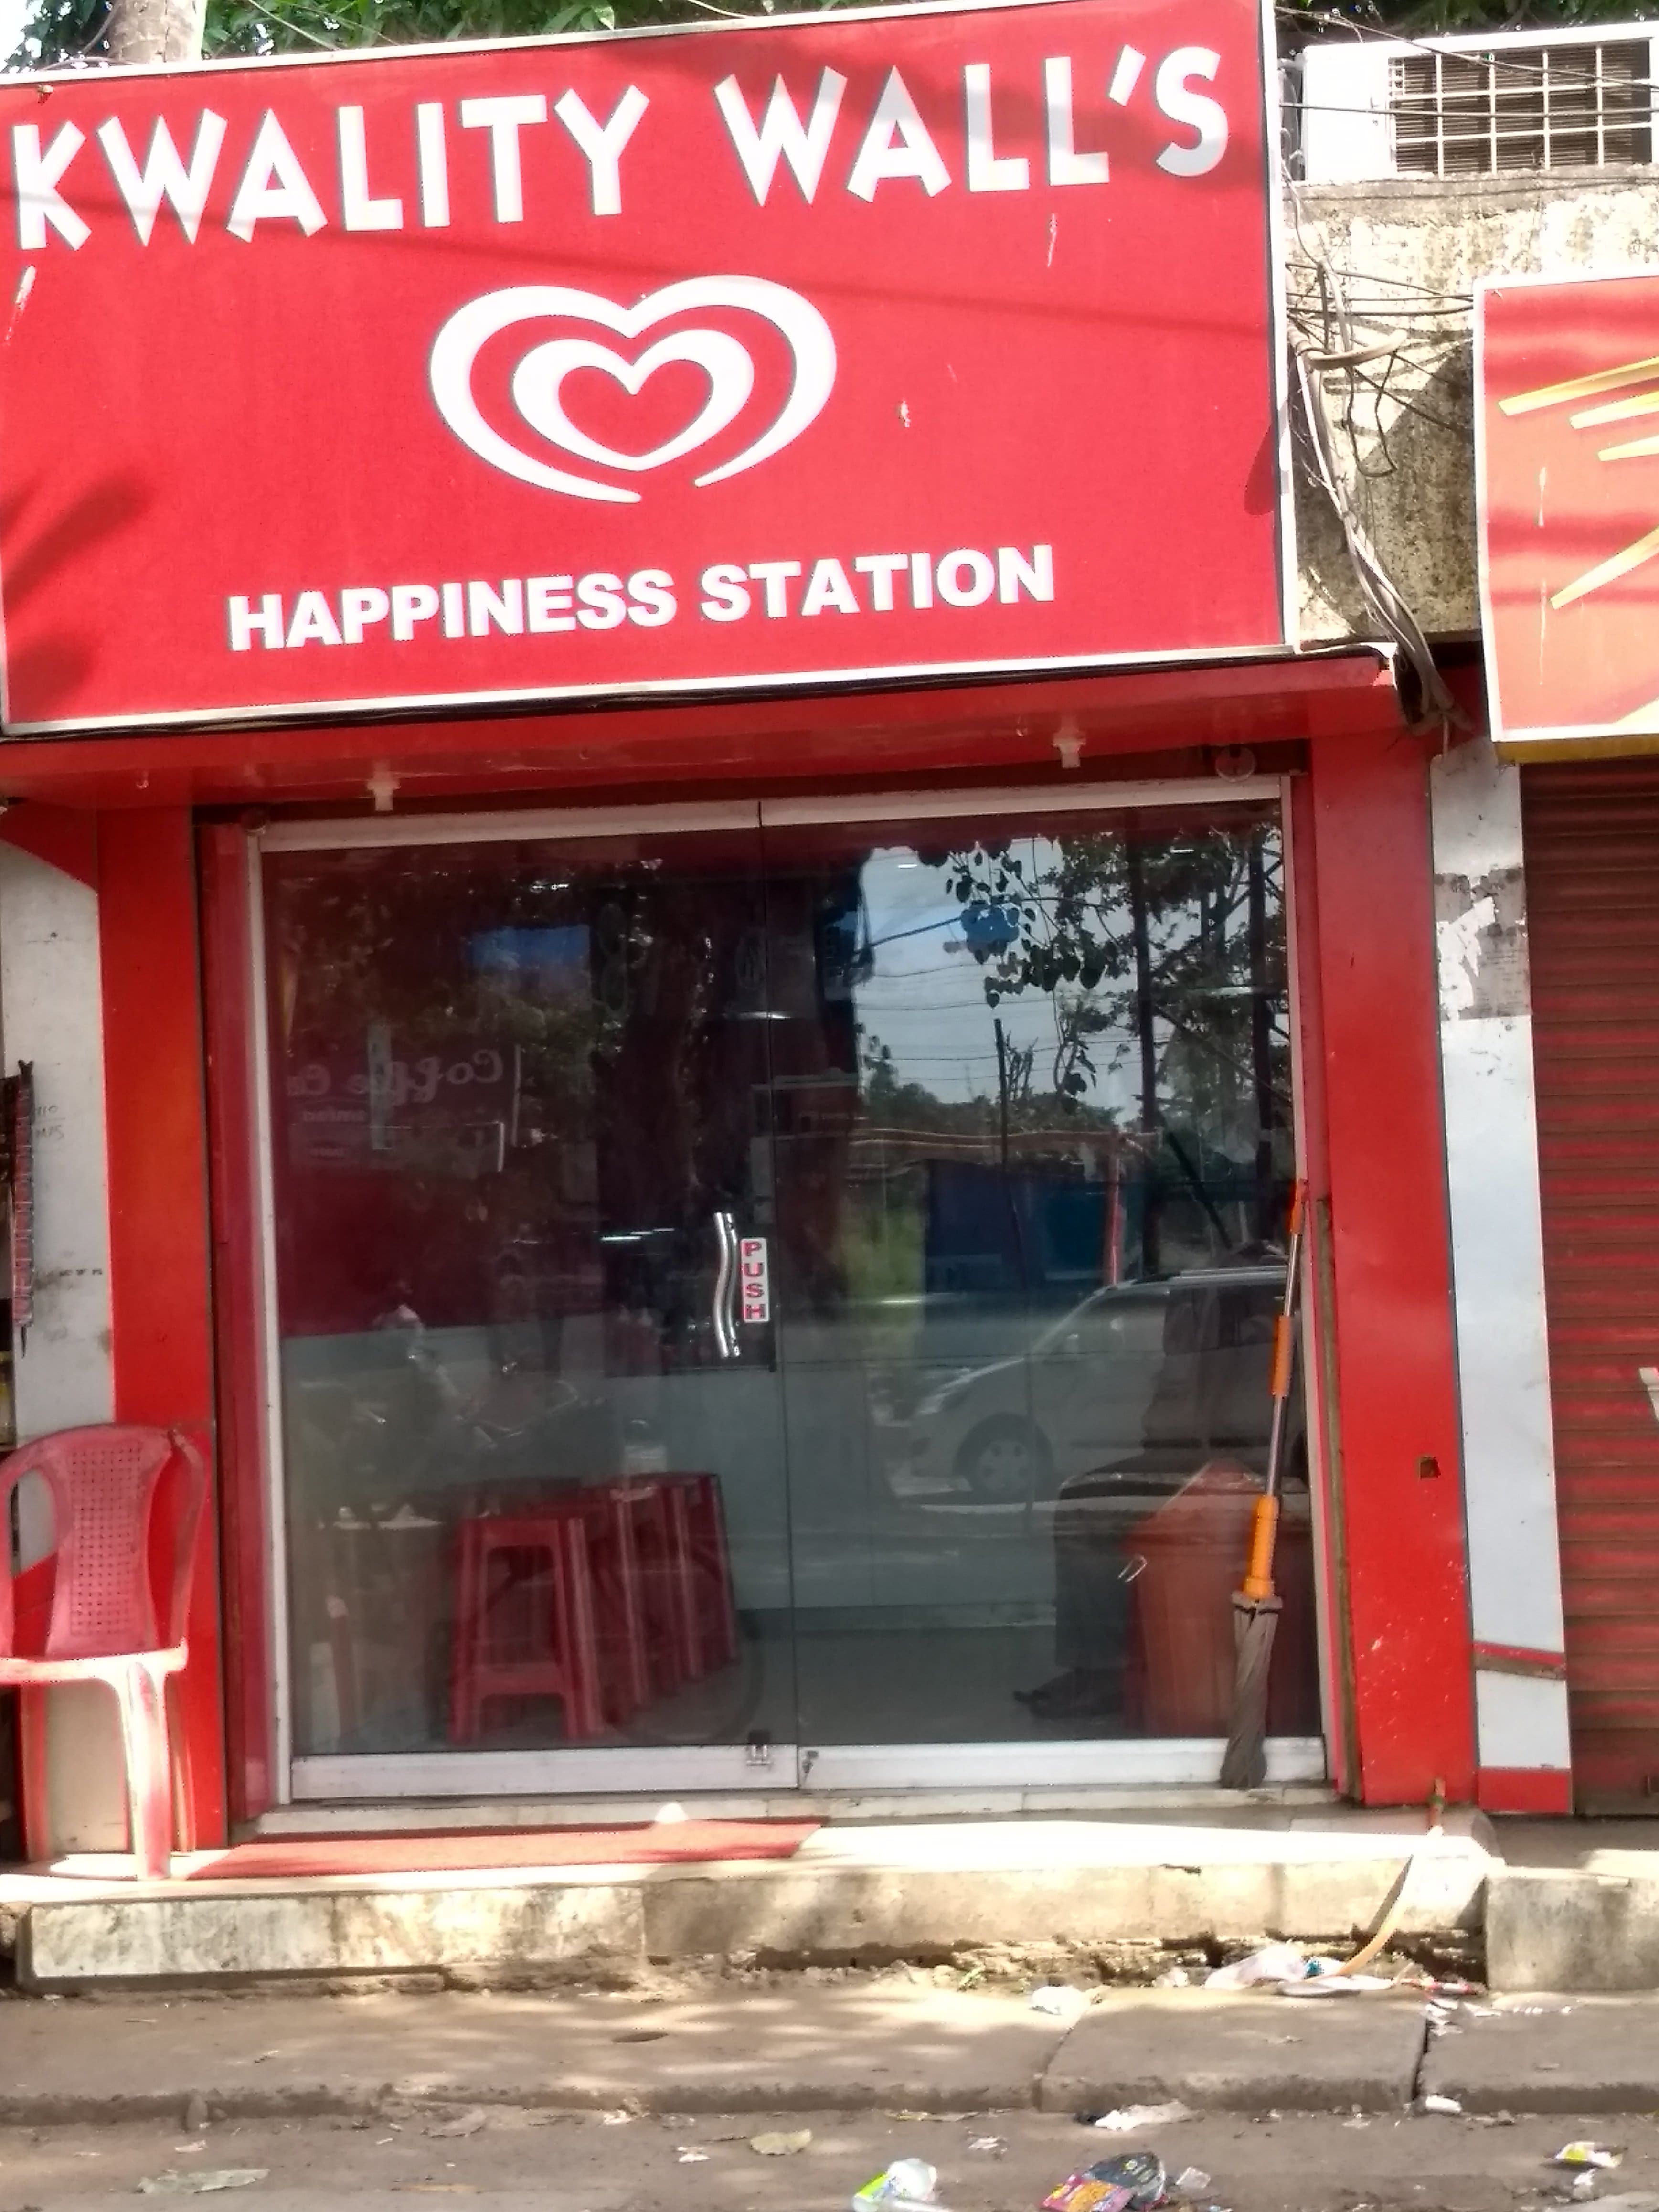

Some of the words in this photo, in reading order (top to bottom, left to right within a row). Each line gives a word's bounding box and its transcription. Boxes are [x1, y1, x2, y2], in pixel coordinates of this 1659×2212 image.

[12, 85, 650, 251] KWALITY
[713, 44, 1229, 207] WALL'S
[228, 569, 677, 651] HAPPINESS
[700, 544, 1055, 622] STATION
[743, 1242, 765, 1319] PUSH
